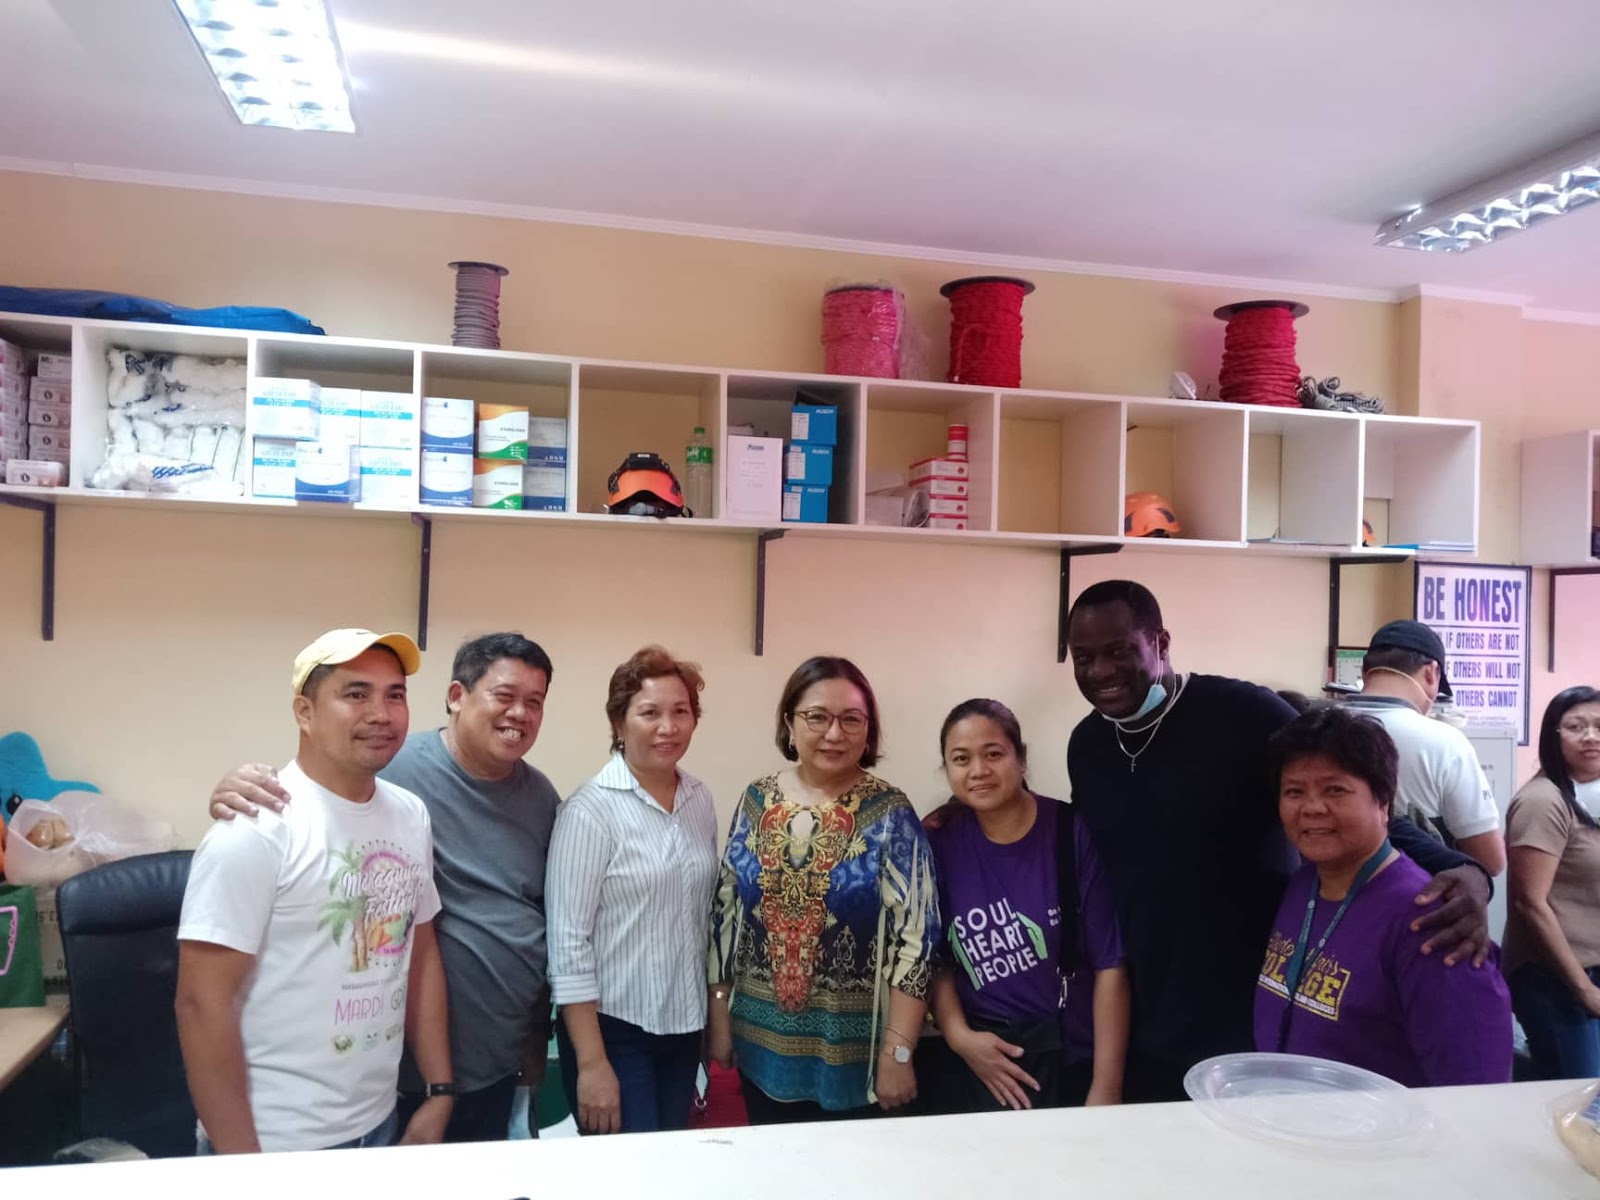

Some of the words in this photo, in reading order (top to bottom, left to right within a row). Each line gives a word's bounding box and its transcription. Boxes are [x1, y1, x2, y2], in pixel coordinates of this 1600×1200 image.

[1423, 577, 1446, 621] BE
[1454, 578, 1522, 623] HONEST
[1446, 634, 1454, 649] IF
[1455, 633, 1485, 650] OTHERS
[1488, 634, 1502, 650] ARE
[1505, 634, 1520, 651] NOT
[1453, 661, 1482, 679] OTHERS
[1485, 662, 1503, 679] WILL
[1506, 662, 1521, 680] NOT
[1455, 690, 1485, 707] OTHERS
[1488, 690, 1518, 708] CANNOT
[953, 897, 1017, 939] SOUL
[961, 921, 1025, 964] HEART
[974, 946, 1038, 986] PEOPLE
[334, 994, 385, 1026] MARDI
